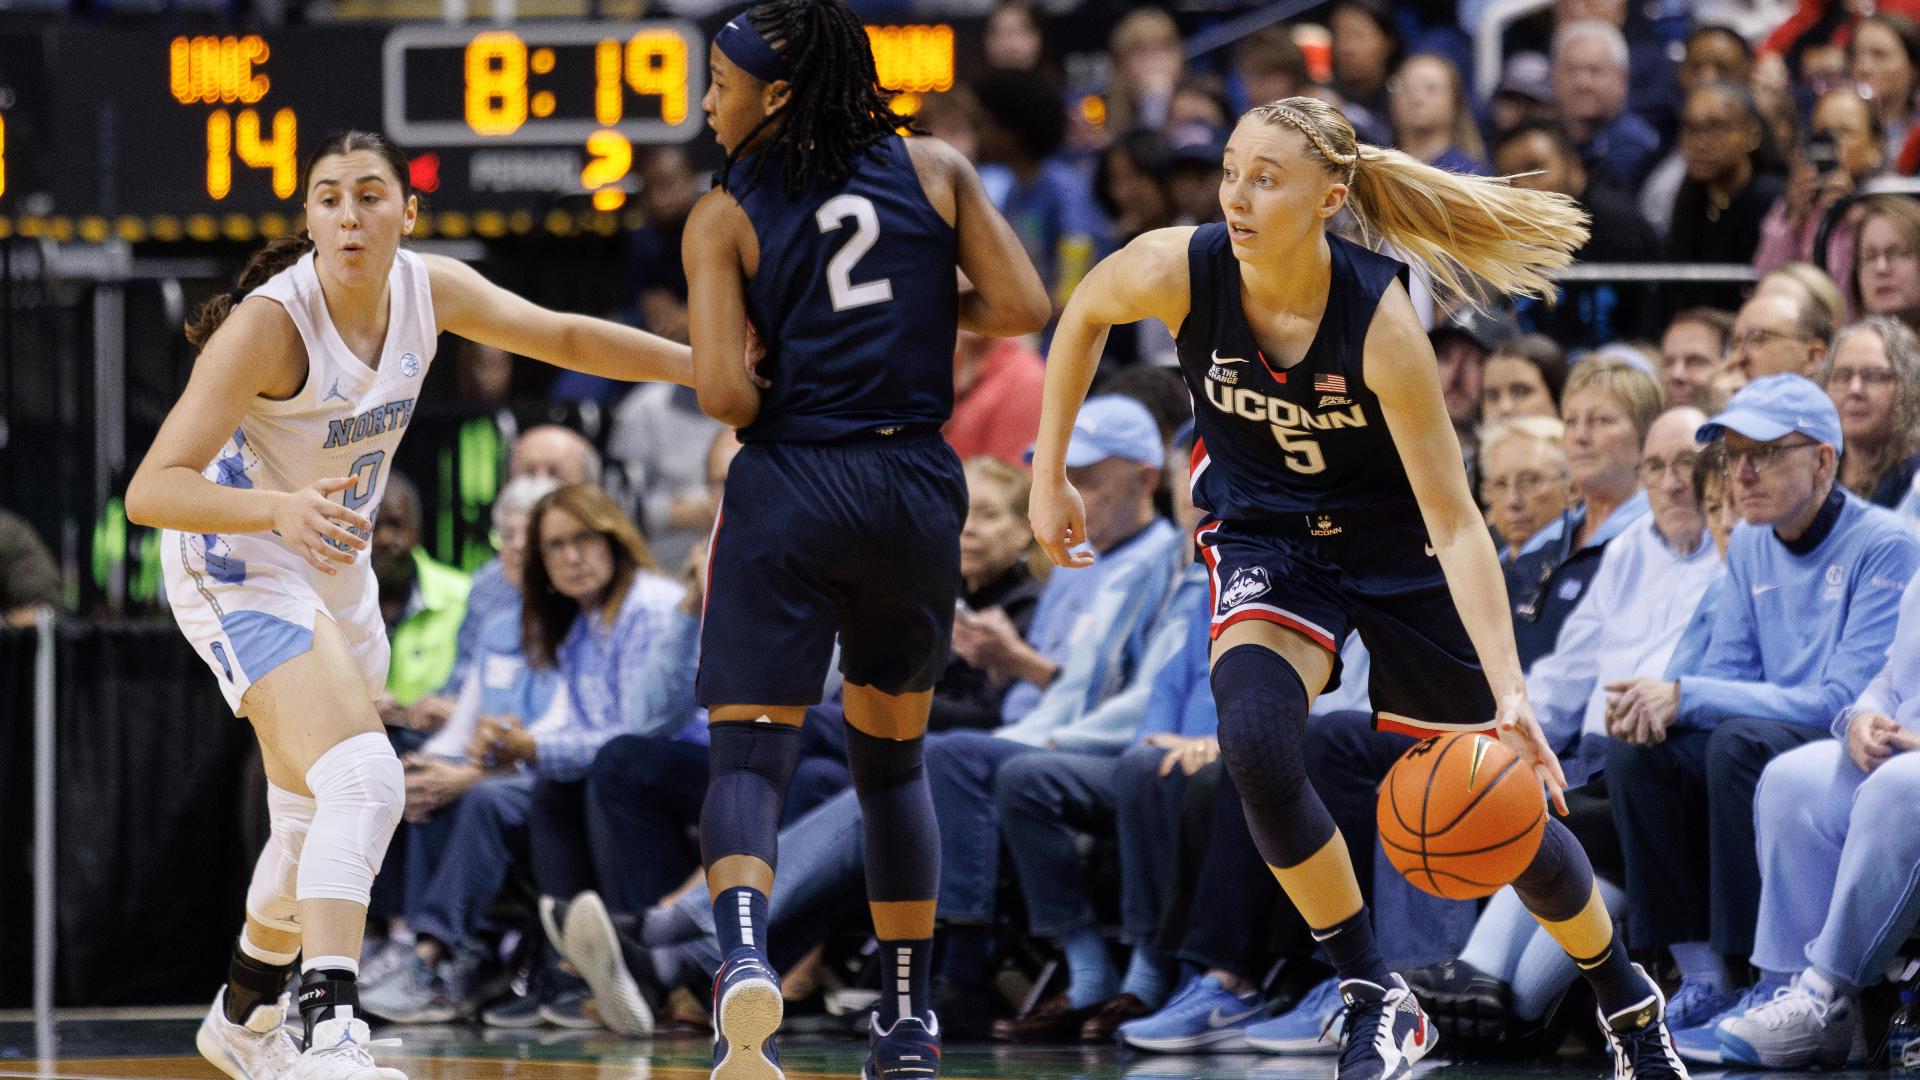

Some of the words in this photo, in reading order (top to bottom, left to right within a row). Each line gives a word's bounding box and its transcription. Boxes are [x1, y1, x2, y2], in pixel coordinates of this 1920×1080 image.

[170, 34, 270, 104] UNC
[464, 29, 689, 137] 8:19
[206, 108, 297, 200] 14
[580, 129, 633, 211] 2
[815, 193, 894, 312] 2
[1208, 369, 1239, 384] CHANGE
[1222, 367, 1239, 378] THE
[322, 398, 415, 449] NORTH
[1204, 375, 1369, 431] UCONN
[1271, 424, 1326, 475] 5
[343, 450, 385, 511] 0
[1310, 526, 1342, 536] UCONN
